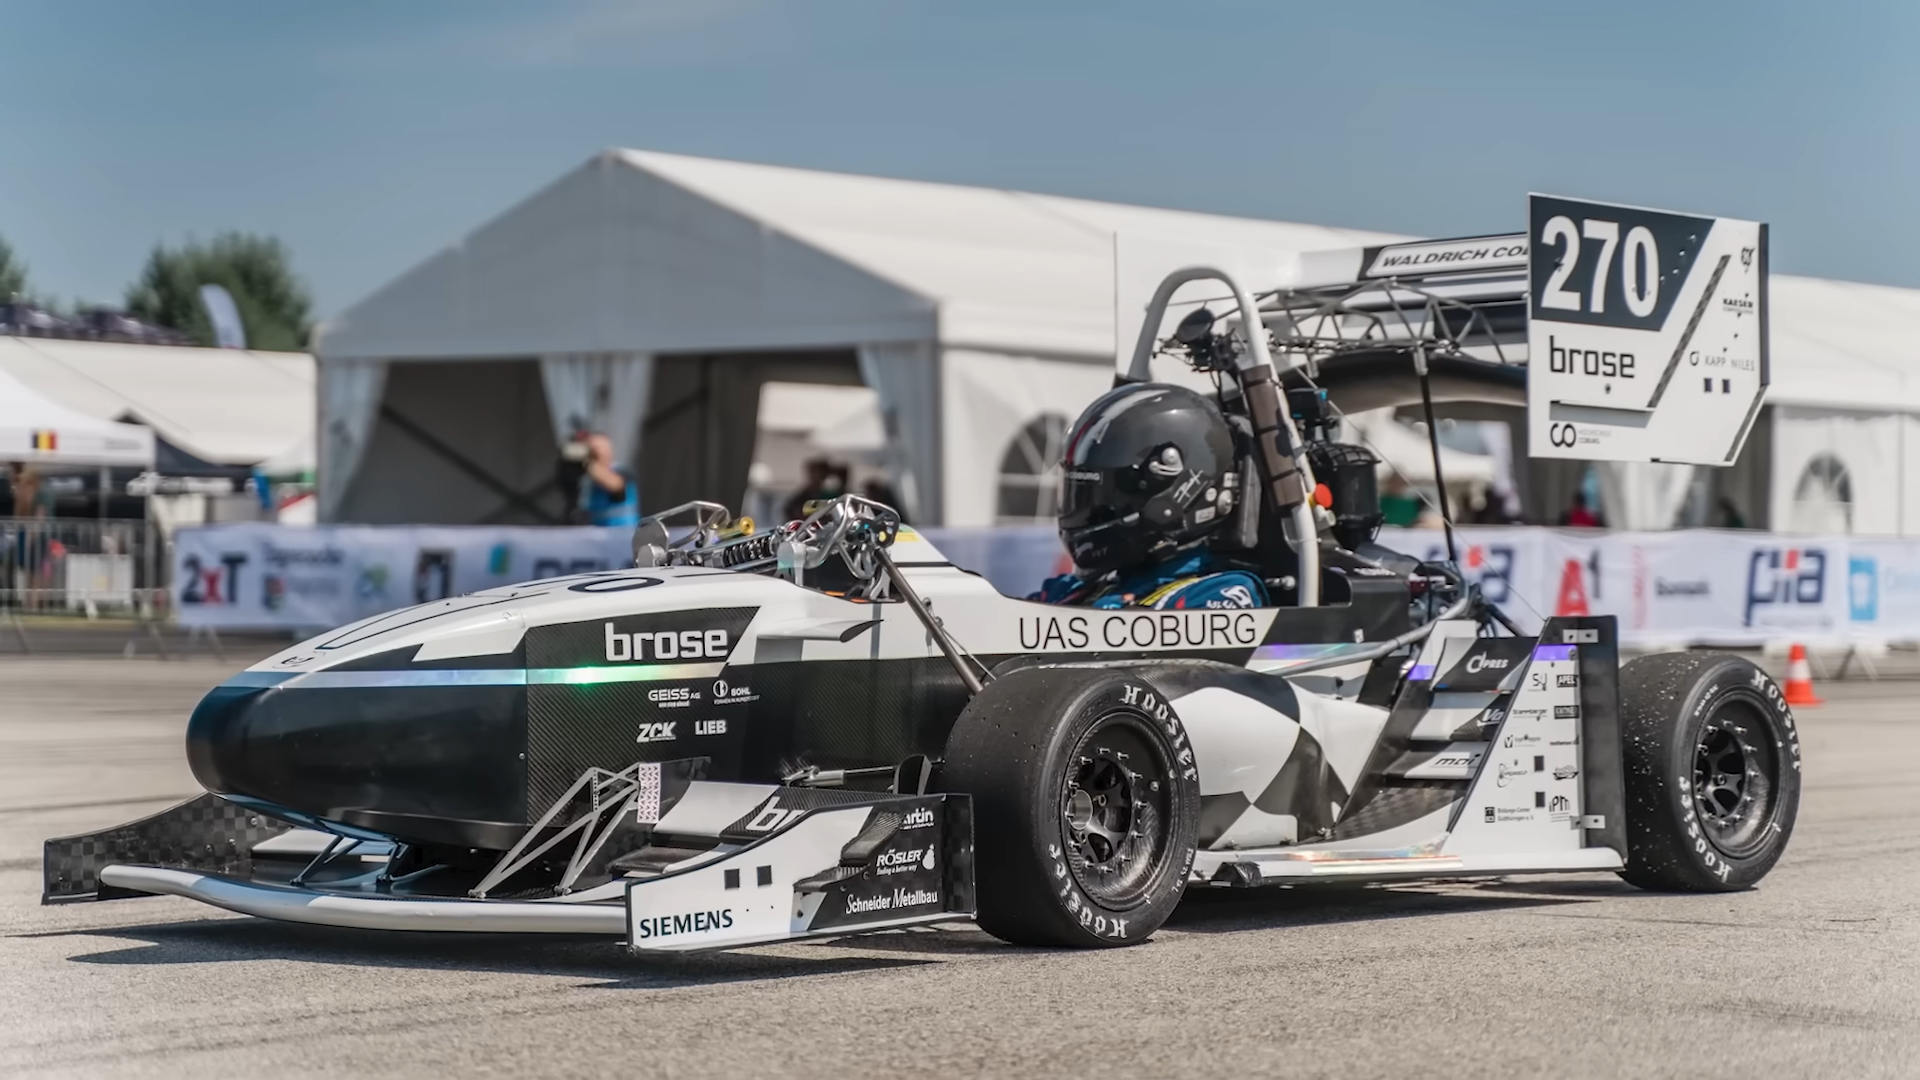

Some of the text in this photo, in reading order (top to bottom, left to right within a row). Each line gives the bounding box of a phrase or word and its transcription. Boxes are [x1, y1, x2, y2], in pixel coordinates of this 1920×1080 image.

[1382, 248, 1489, 268] WALDRICH
[1541, 215, 1659, 317] 270
[1549, 335, 1635, 378] brose
[181, 552, 248, 604] 2xT
[605, 622, 728, 661] brose
[1019, 613, 1256, 650] UAS COBURG
[648, 688, 700, 701] GEISS AG
[636, 722, 676, 743] ZCK
[695, 720, 727, 736] LIEB
[876, 848, 922, 867] RÖSLER
[846, 887, 938, 915] Schneider Metallbau
[639, 908, 733, 939] SIEMENS
